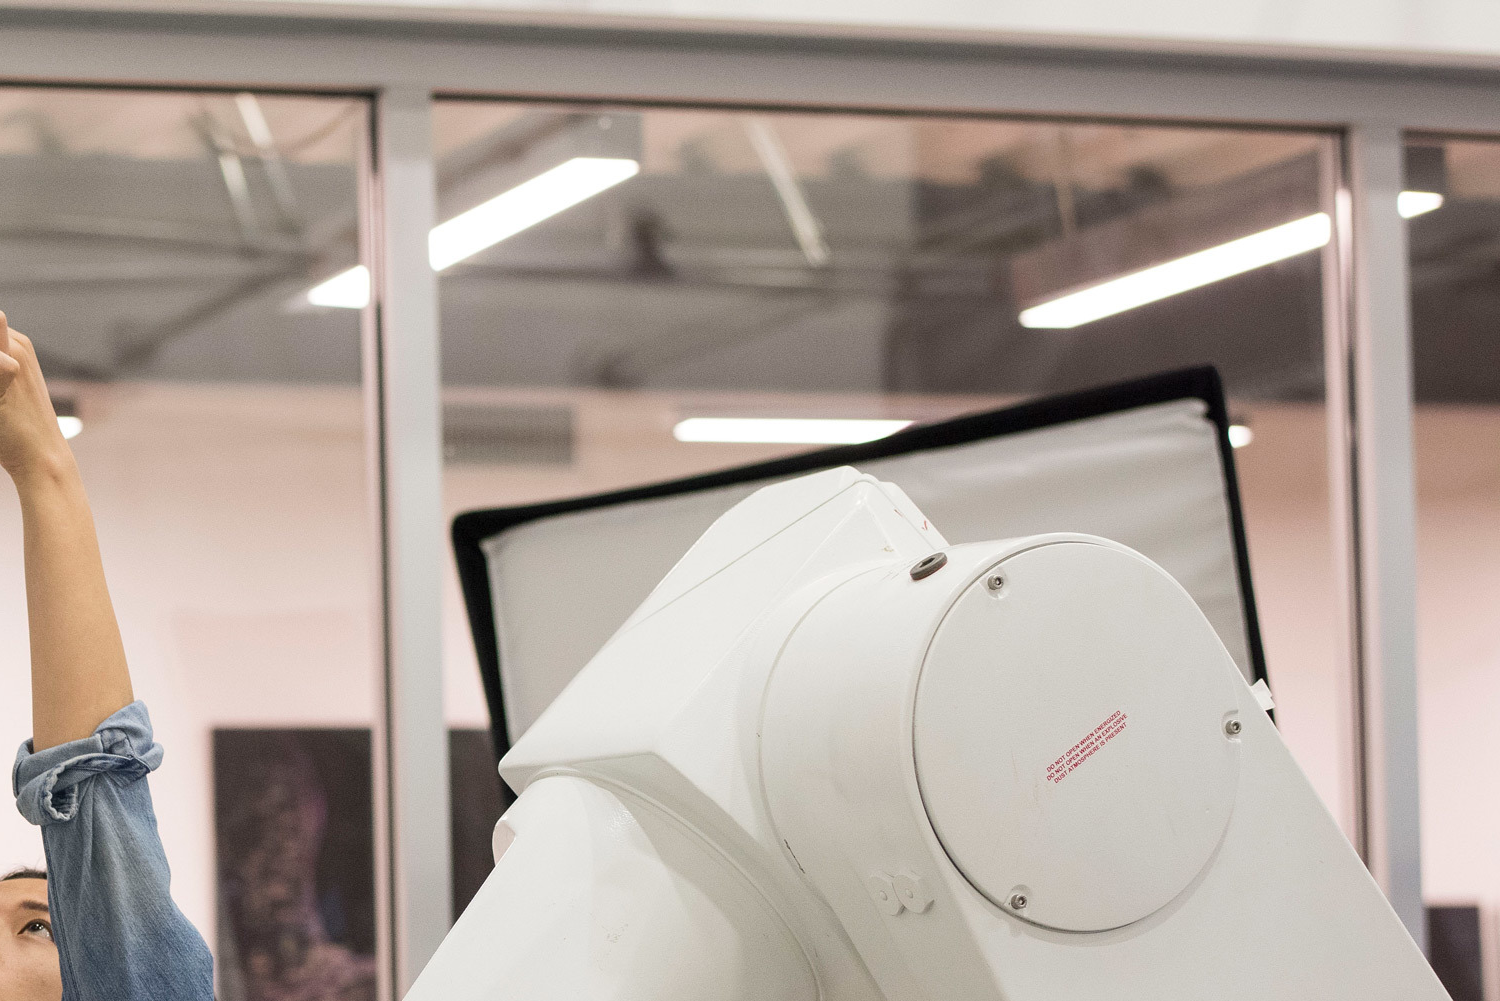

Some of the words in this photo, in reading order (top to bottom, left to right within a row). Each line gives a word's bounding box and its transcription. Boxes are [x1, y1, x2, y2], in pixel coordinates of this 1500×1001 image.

[1047, 764, 1055, 772] DO
[1055, 755, 1064, 765] NOT
[1066, 744, 1080, 757] OPEN
[1079, 733, 1094, 746] WHEN
[1094, 711, 1120, 734] ENERGIZED
[1047, 772, 1054, 780] DO
[1055, 764, 1065, 774] NOT
[1066, 753, 1080, 765] OPEN
[1079, 741, 1094, 754] WHEN
[1102, 714, 1127, 736] EXPLOSIVE
[1054, 770, 1067, 783] DUST
[1068, 745, 1099, 772] ATMOSPHERE
[1105, 723, 1126, 742] PRESENT
